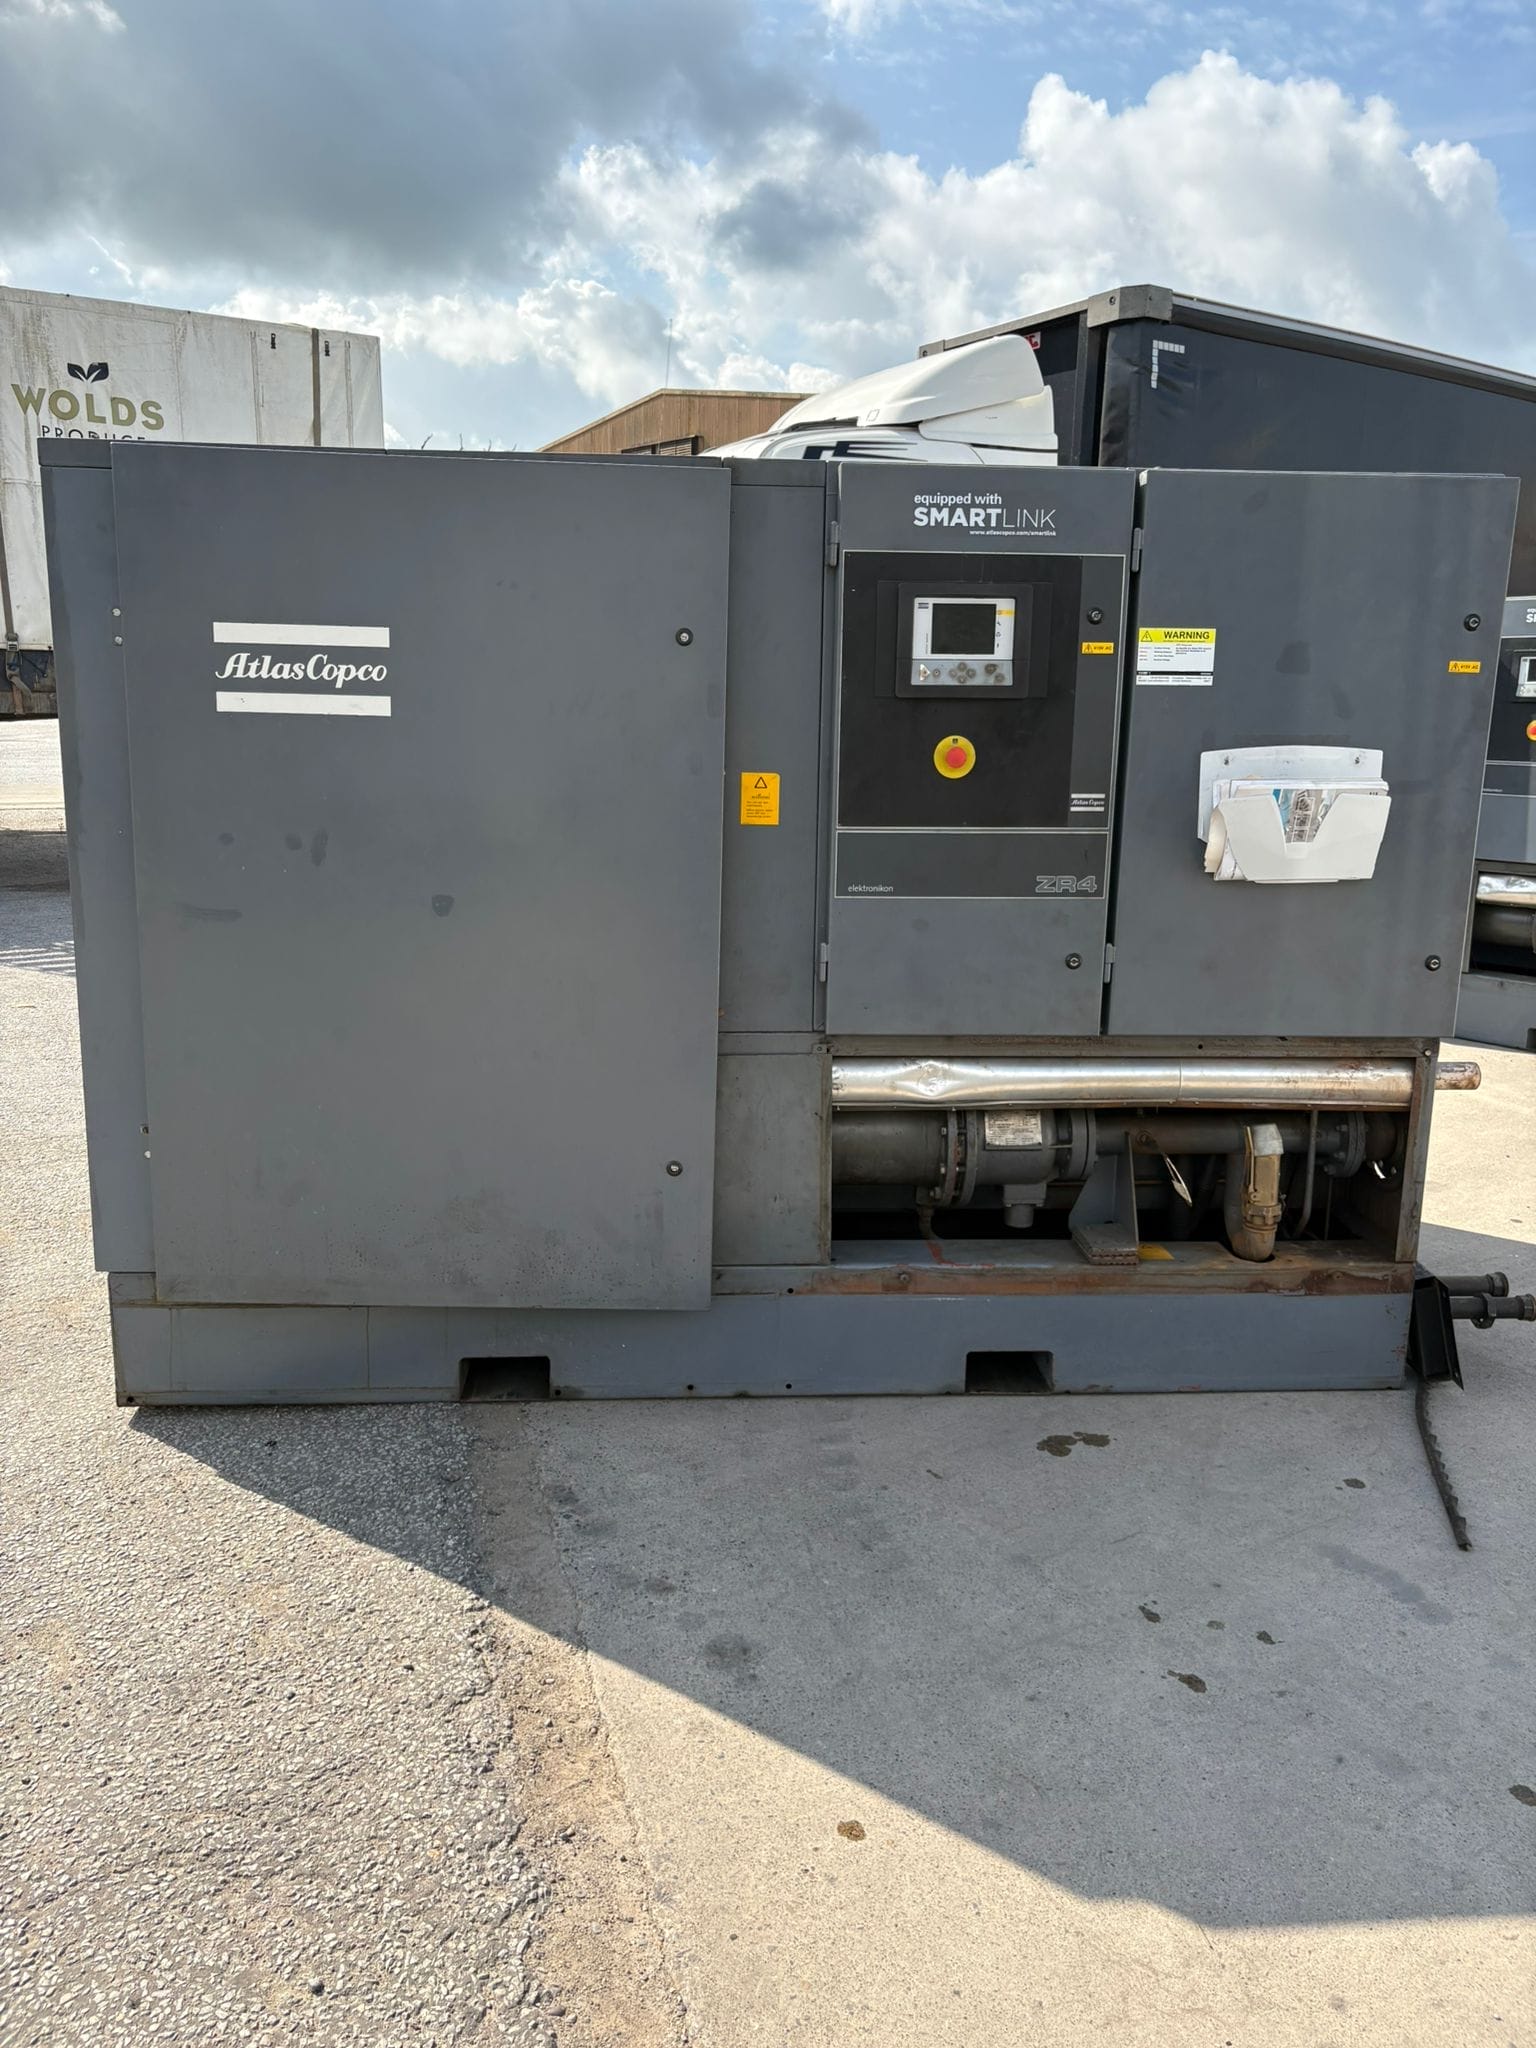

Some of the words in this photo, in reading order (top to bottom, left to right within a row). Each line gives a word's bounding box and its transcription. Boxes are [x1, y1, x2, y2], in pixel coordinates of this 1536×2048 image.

[11, 384, 164, 430] WOLDS
[914, 493, 971, 507] equipped
[974, 493, 1002, 505] with
[1163, 631, 1210, 640] WARNING
[848, 884, 894, 893] elektronikon
[1035, 875, 1098, 893] ZR4
